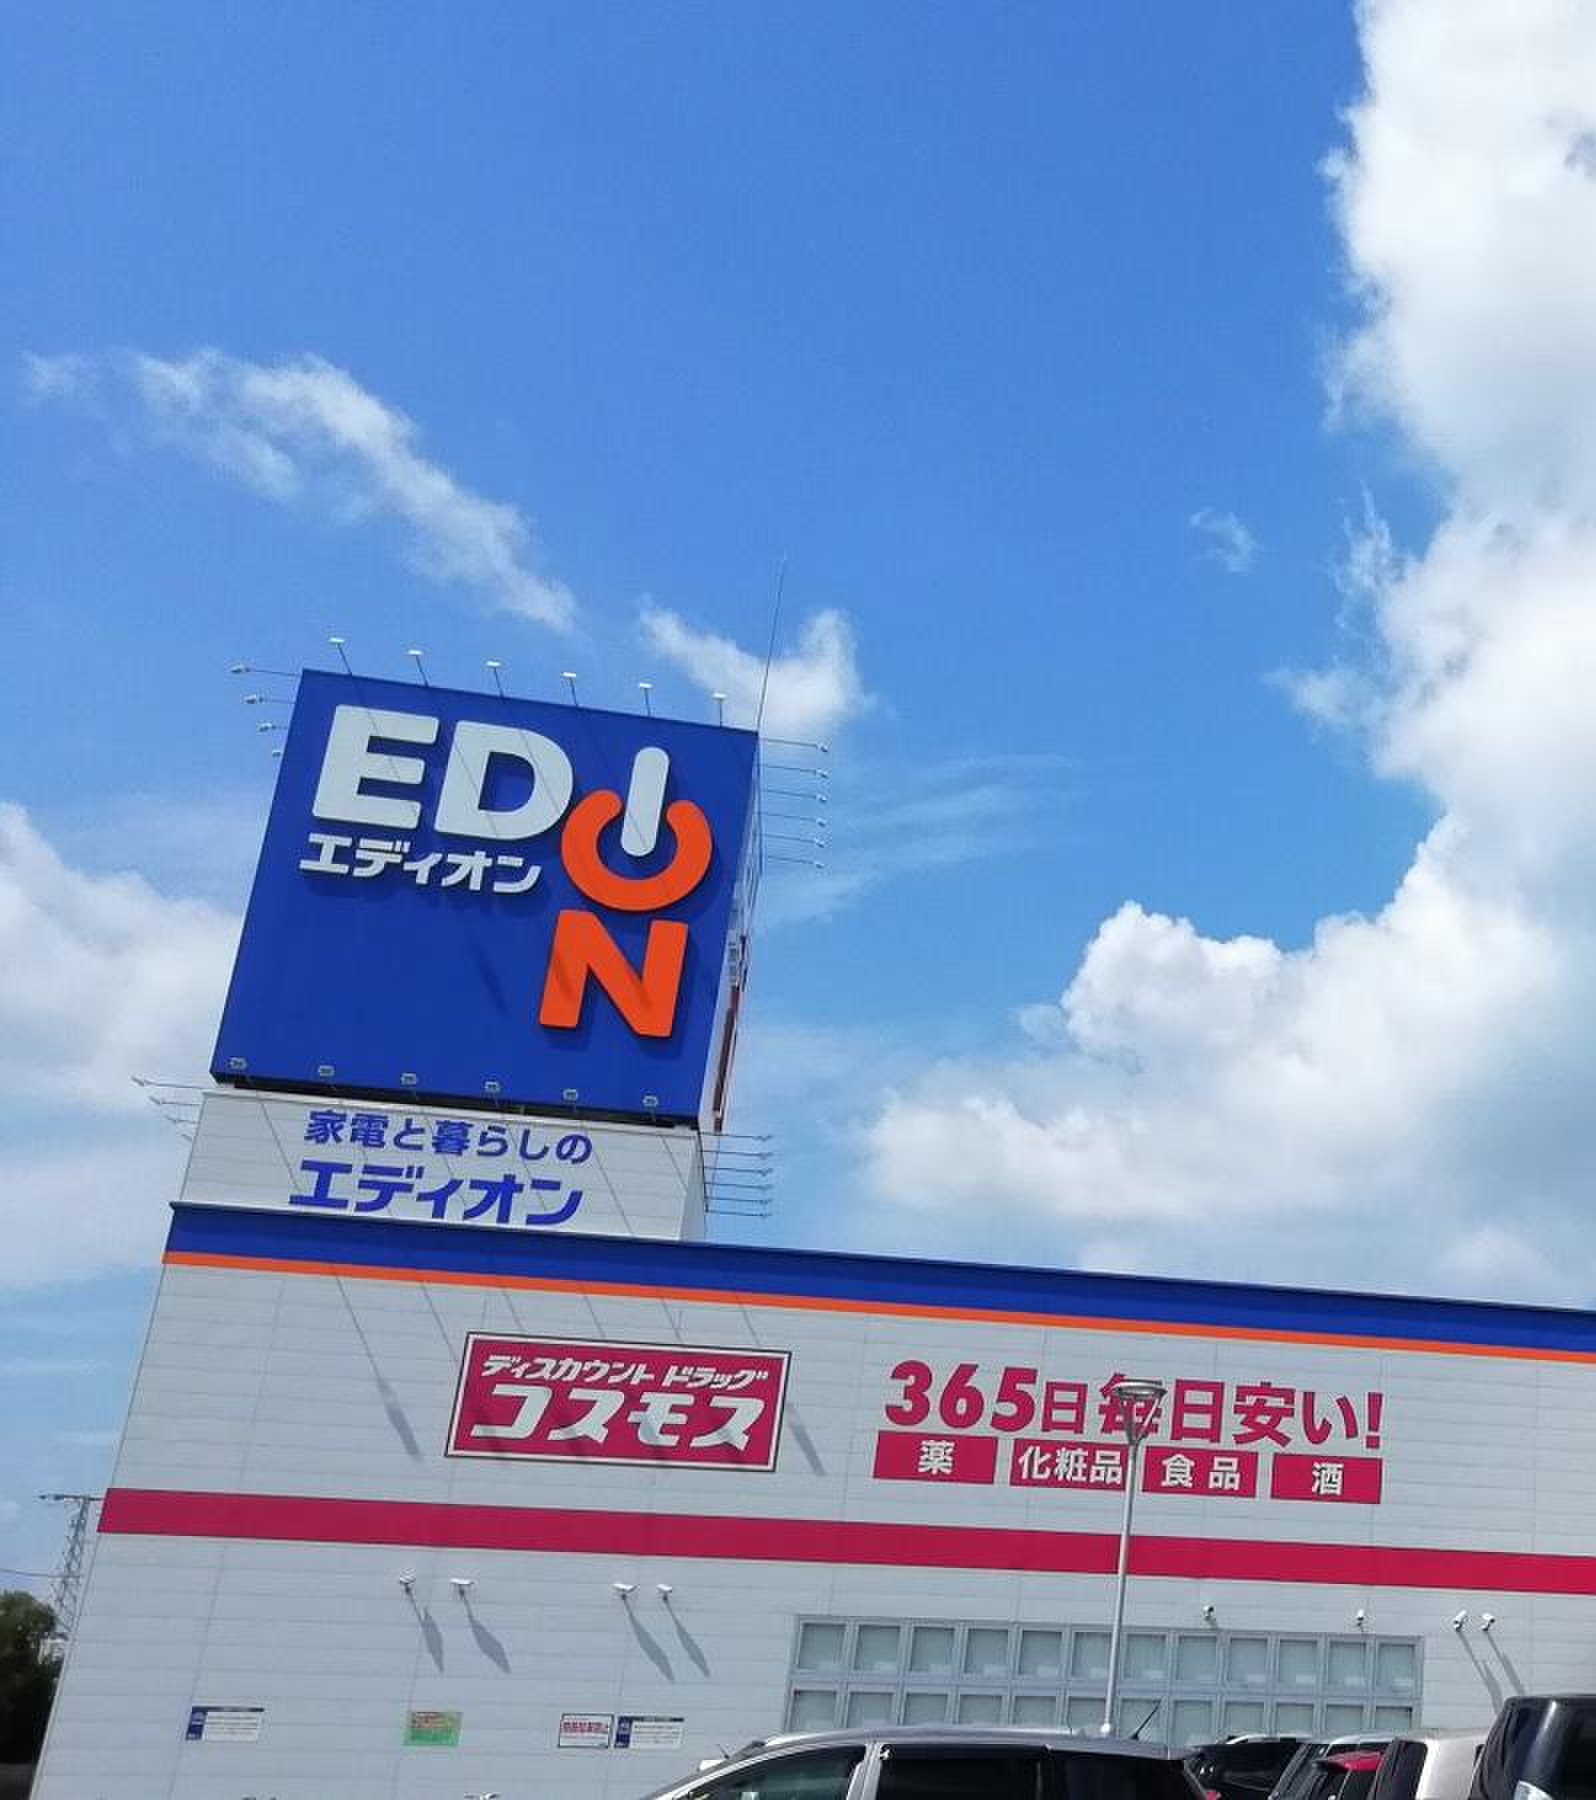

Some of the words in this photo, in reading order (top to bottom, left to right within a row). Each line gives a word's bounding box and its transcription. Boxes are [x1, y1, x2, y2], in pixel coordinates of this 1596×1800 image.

[299, 833, 541, 893] エディオン
[303, 1109, 593, 1165] 家電と暮らしの
[289, 1159, 583, 1225] エディオン
[482, 1355, 655, 1386] ディスカウント
[662, 1365, 769, 1390] ドラッグ
[471, 1384, 766, 1451] コスモス
[917, 1440, 956, 1475] 薬
[1018, 1447, 1124, 1484] 化粧品
[1161, 1454, 1242, 1490] 食品
[1311, 1462, 1345, 1496] 酒
